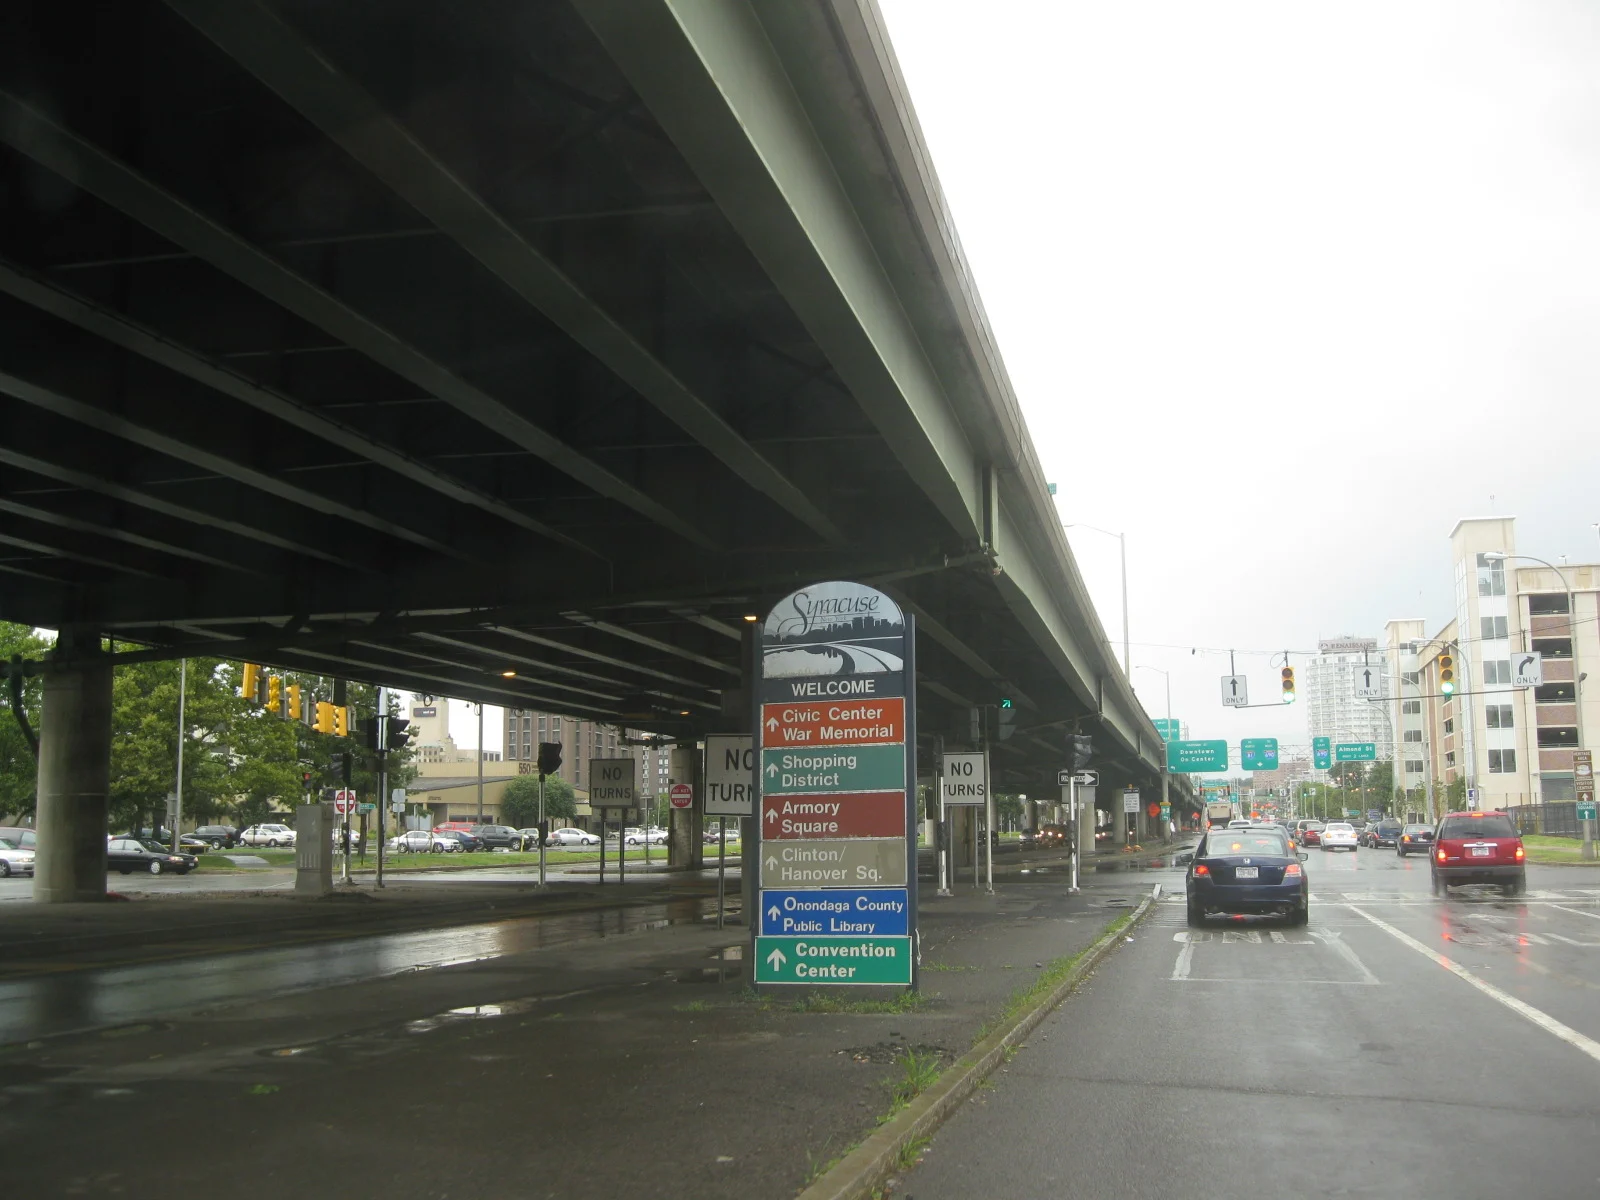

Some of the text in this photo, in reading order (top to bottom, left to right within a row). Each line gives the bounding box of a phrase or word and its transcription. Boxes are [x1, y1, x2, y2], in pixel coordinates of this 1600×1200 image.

[789, 592, 879, 634] Syracuse
[792, 680, 875, 696] WELCOME
[783, 706, 883, 723] Civic Center
[783, 724, 893, 741] War Memorial
[725, 748, 752, 770] NO
[782, 754, 857, 771] Shopping
[518, 763, 531, 775] 550
[602, 767, 621, 780] NO
[951, 762, 973, 776] NO
[782, 773, 839, 788] District
[593, 787, 631, 799] TURNS
[782, 801, 840, 816] Armory
[782, 819, 838, 834] Square
[782, 846, 847, 863] Clinton/
[782, 866, 882, 882] Hanover Sq.
[784, 896, 903, 913] Onondaga County
[783, 917, 875, 934] Public Library
[795, 943, 896, 957] Convention
[795, 963, 856, 978] Center
